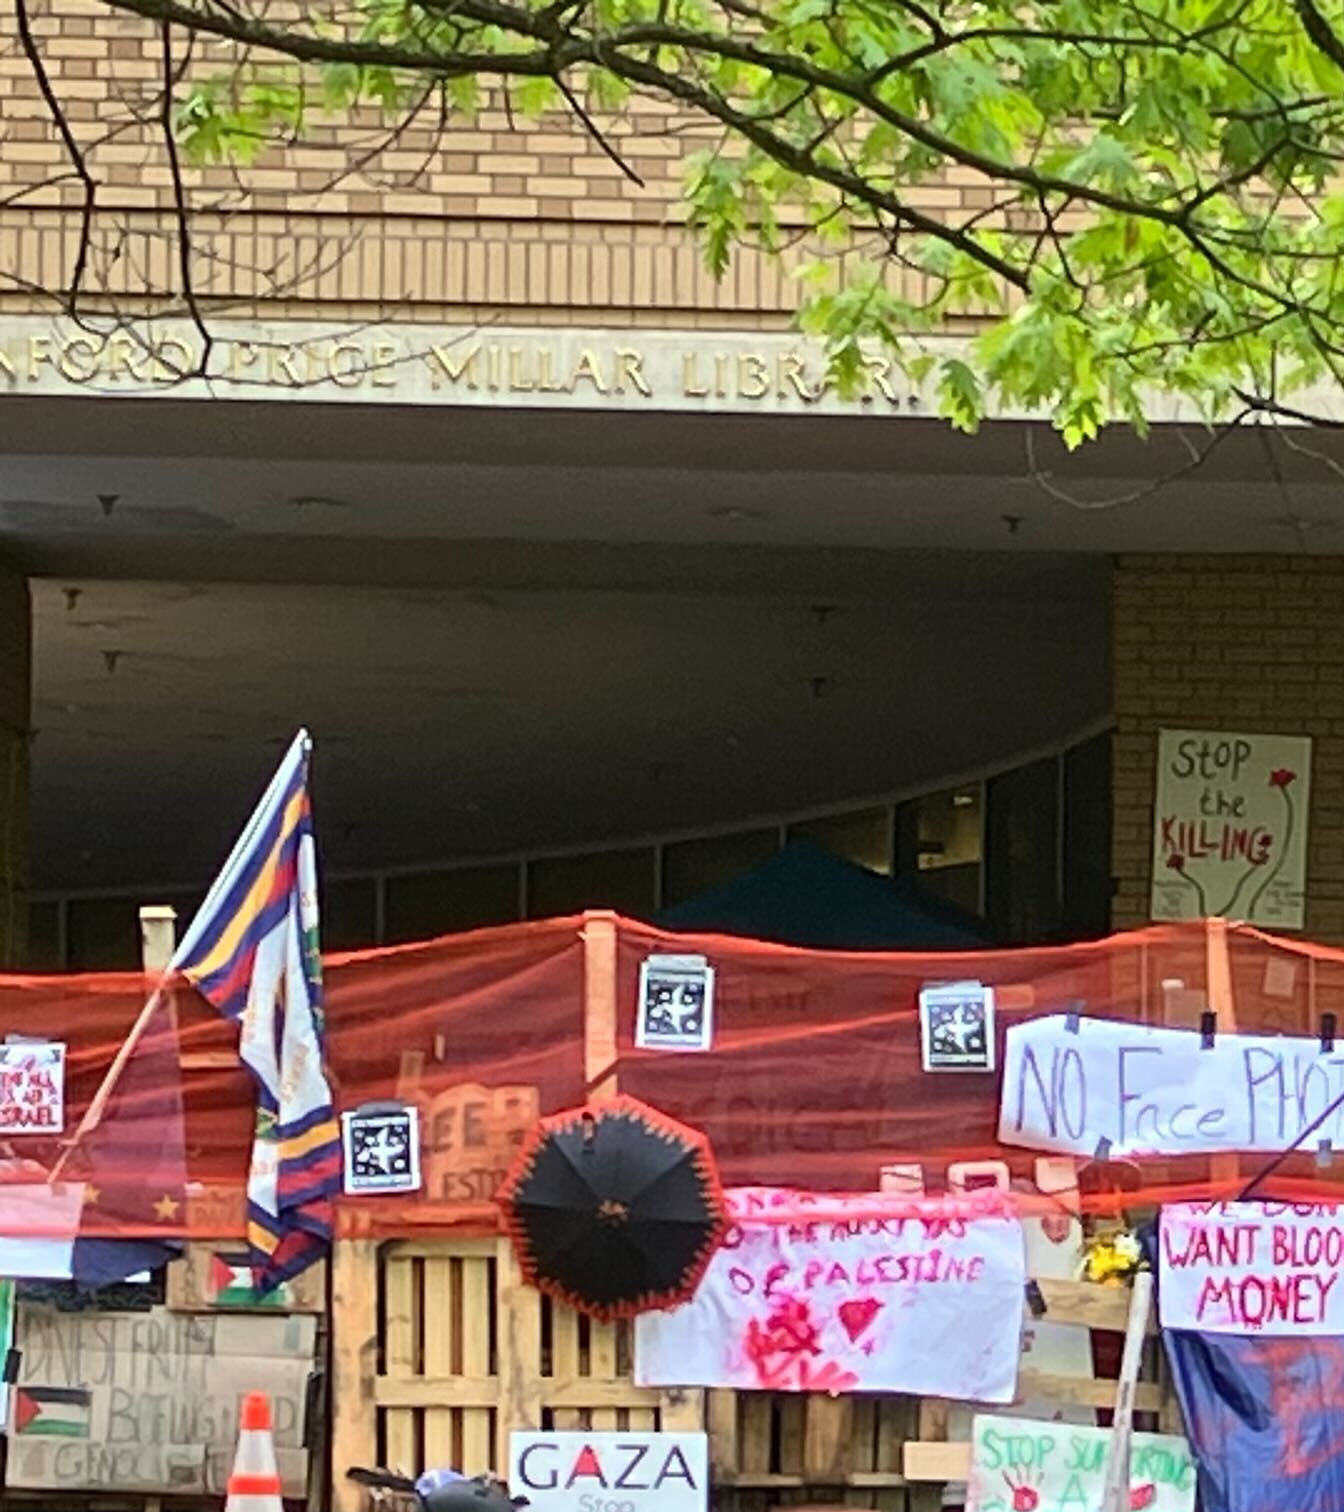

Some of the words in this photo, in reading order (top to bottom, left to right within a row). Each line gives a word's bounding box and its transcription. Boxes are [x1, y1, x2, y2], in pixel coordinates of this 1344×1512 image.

[229, 341, 400, 389] PRICE
[430, 344, 653, 398] MILLAR
[1201, 787, 1249, 819] the
[1162, 817, 1272, 863] KILLING
[1016, 1042, 1088, 1142] NO
[803, 1248, 985, 1290] PALESTINE
[1163, 1225, 1262, 1269] WANT
[1195, 1271, 1339, 1327] MONEY
[518, 1442, 698, 1491] GAZA
[981, 1428, 1055, 1471] STOP
